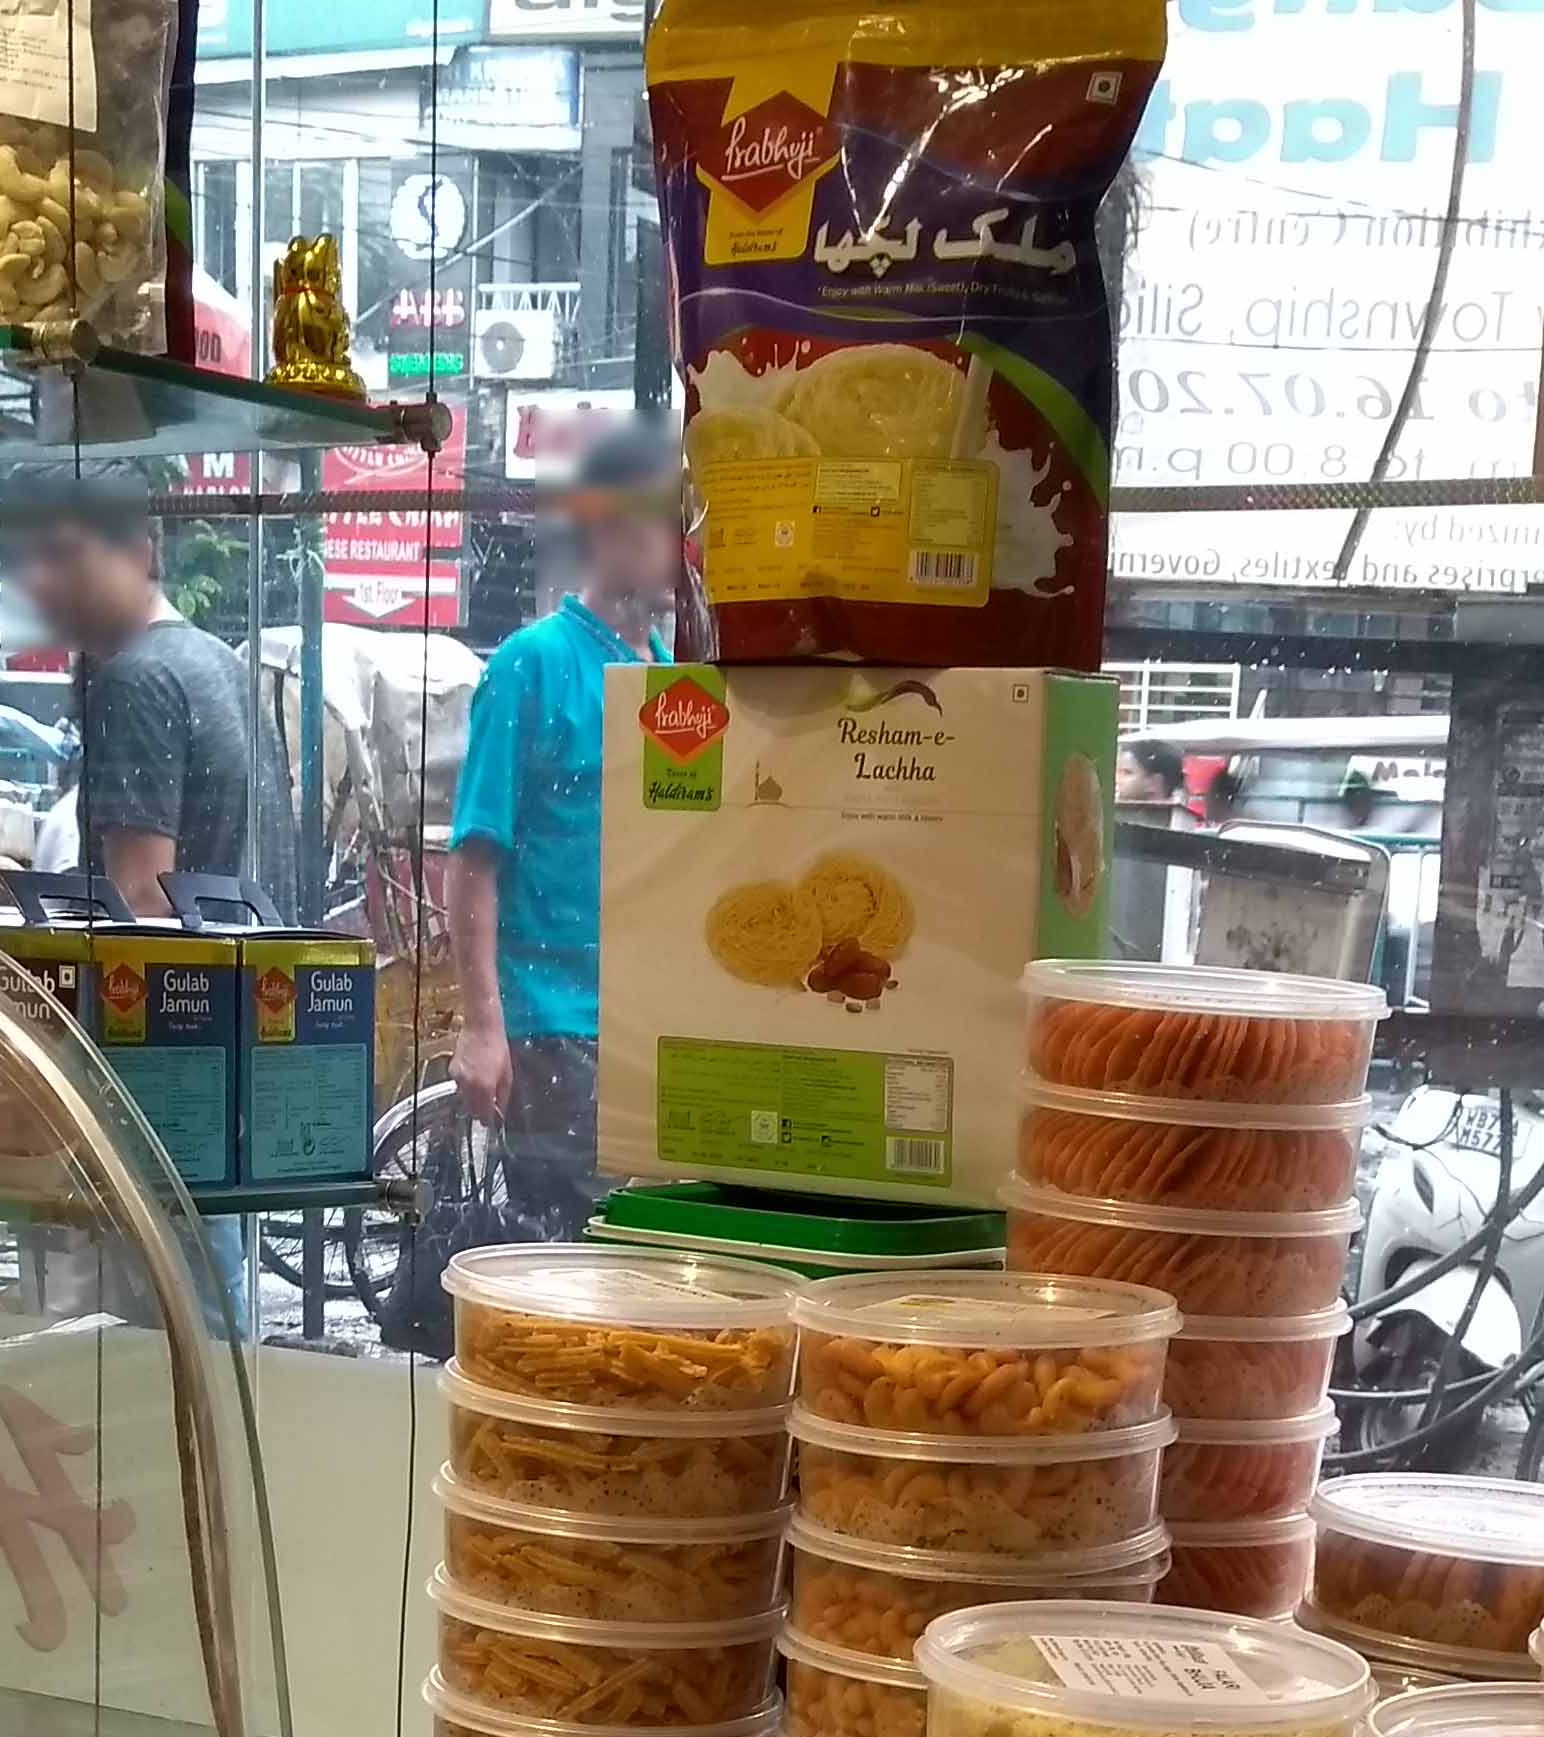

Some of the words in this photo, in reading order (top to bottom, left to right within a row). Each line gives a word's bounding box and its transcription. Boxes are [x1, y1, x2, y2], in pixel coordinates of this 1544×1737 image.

[350, 540, 421, 561] RESTAURANT
[837, 717, 956, 746] Resham-e-
[853, 752, 937, 781] Lachha
[163, 968, 210, 993] Gulab
[310, 970, 353, 993] Gulab
[159, 992, 210, 1015] Jamun
[306, 992, 353, 1014] Jamun
